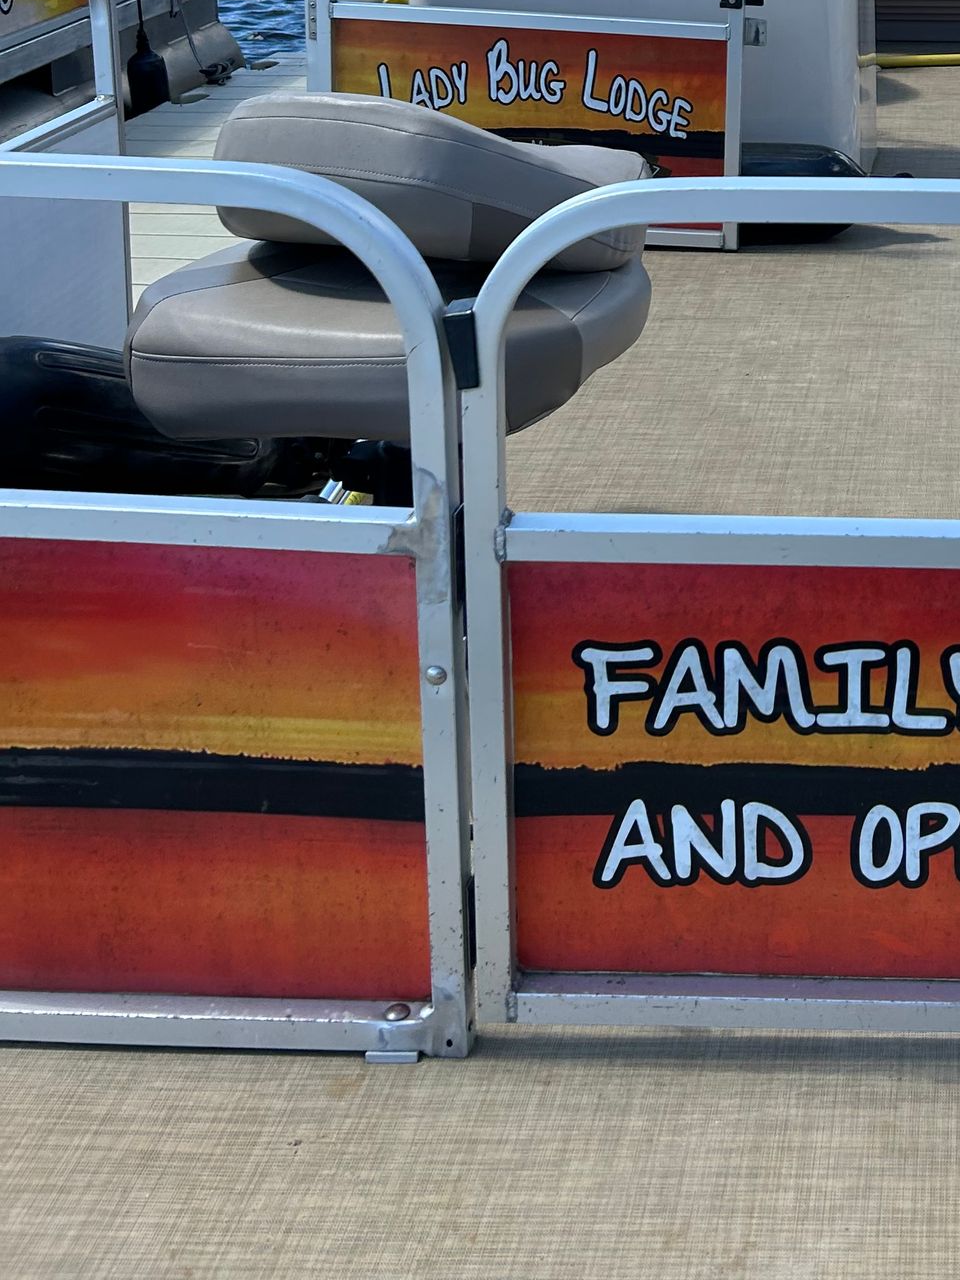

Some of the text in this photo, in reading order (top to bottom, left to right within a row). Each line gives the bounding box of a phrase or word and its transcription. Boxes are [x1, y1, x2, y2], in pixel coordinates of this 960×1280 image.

[486, 37, 567, 106] BUG
[582, 47, 694, 140] LODGE
[593, 797, 812, 889] AND
